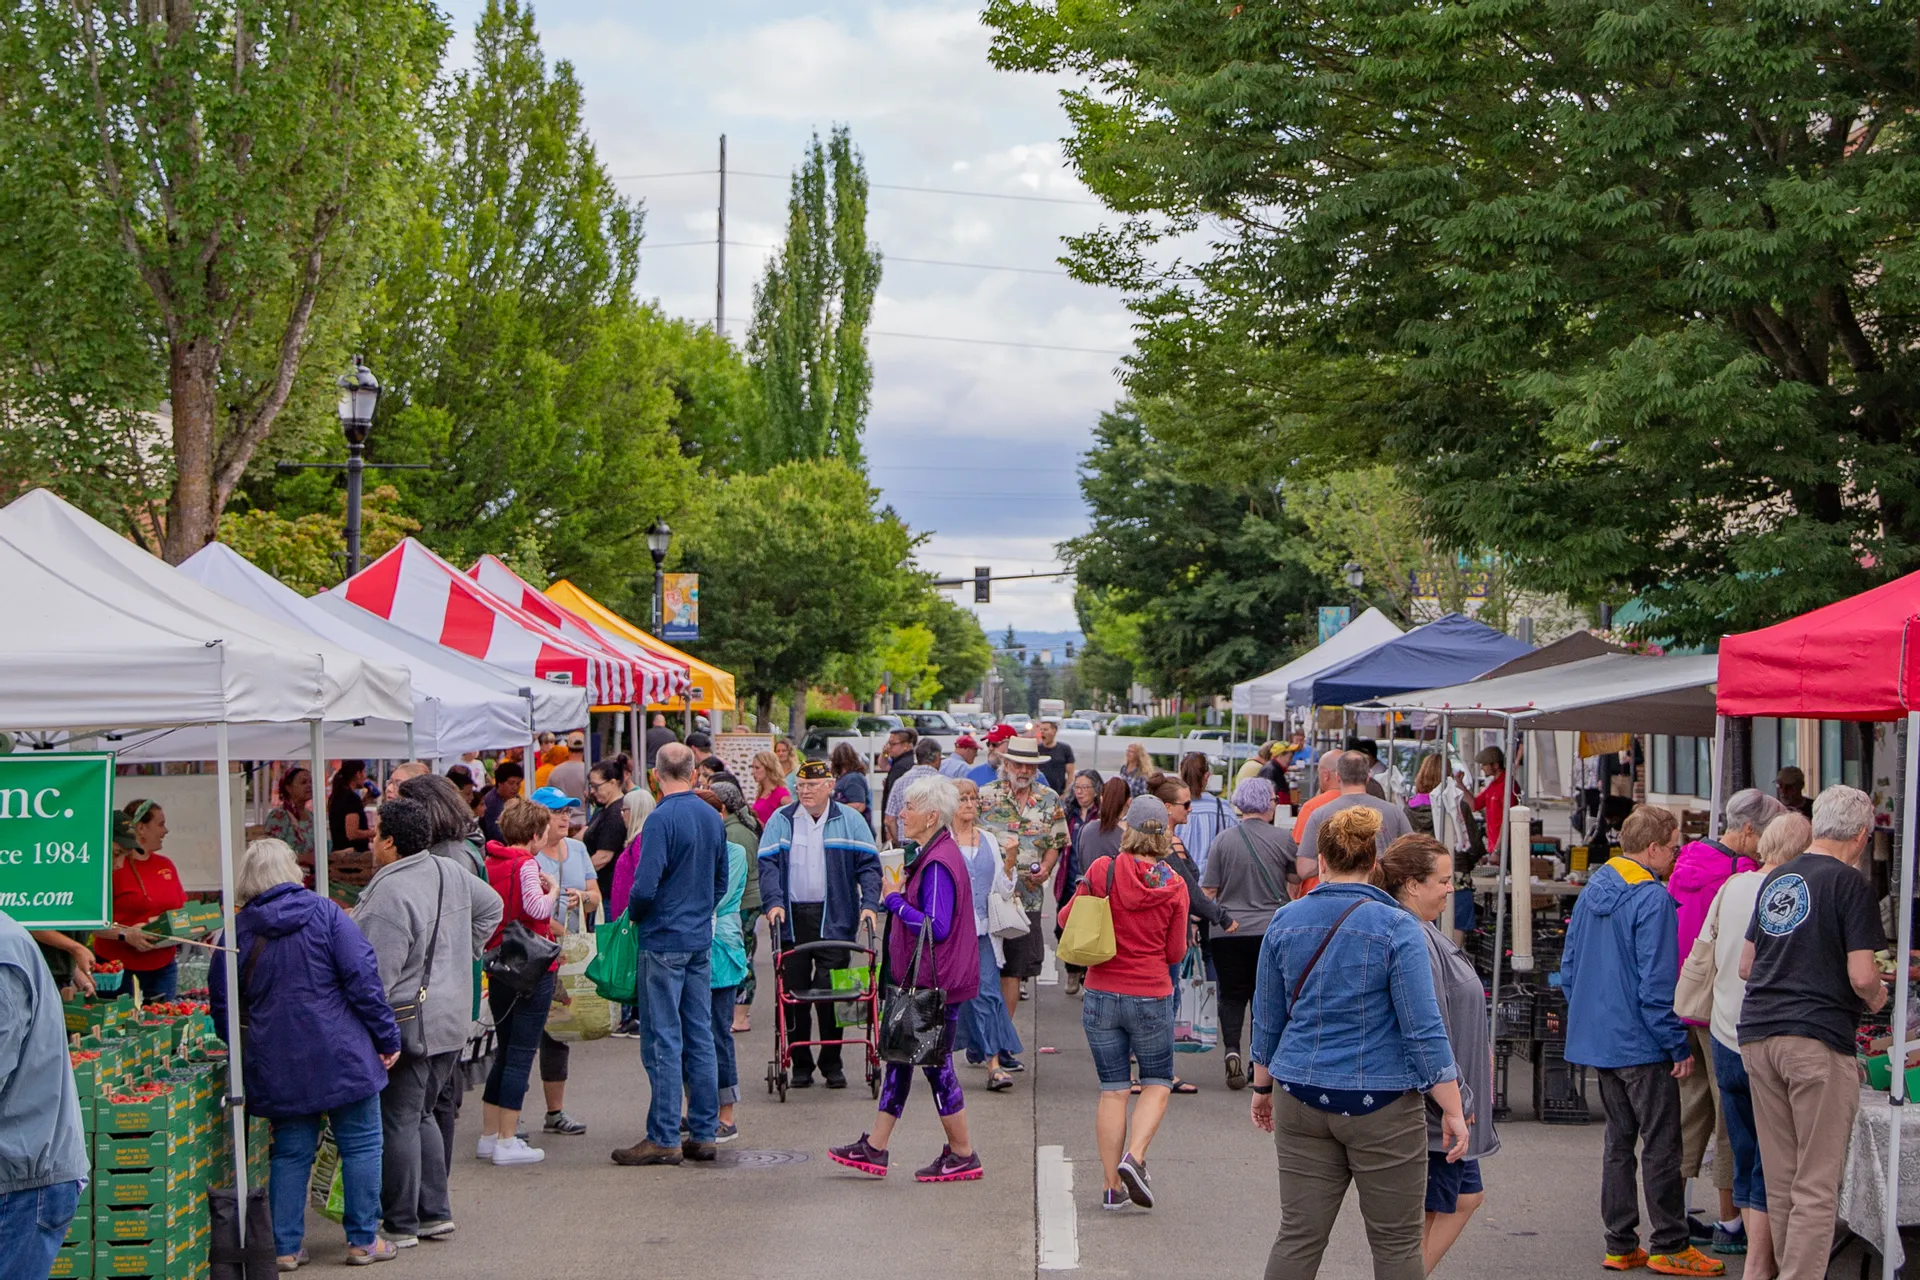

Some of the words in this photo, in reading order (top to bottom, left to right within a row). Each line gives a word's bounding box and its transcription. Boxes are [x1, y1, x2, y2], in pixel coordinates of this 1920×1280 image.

[0, 788, 74, 818] nc.
[33, 841, 90, 865] 1984
[0, 891, 74, 907] ms.com
